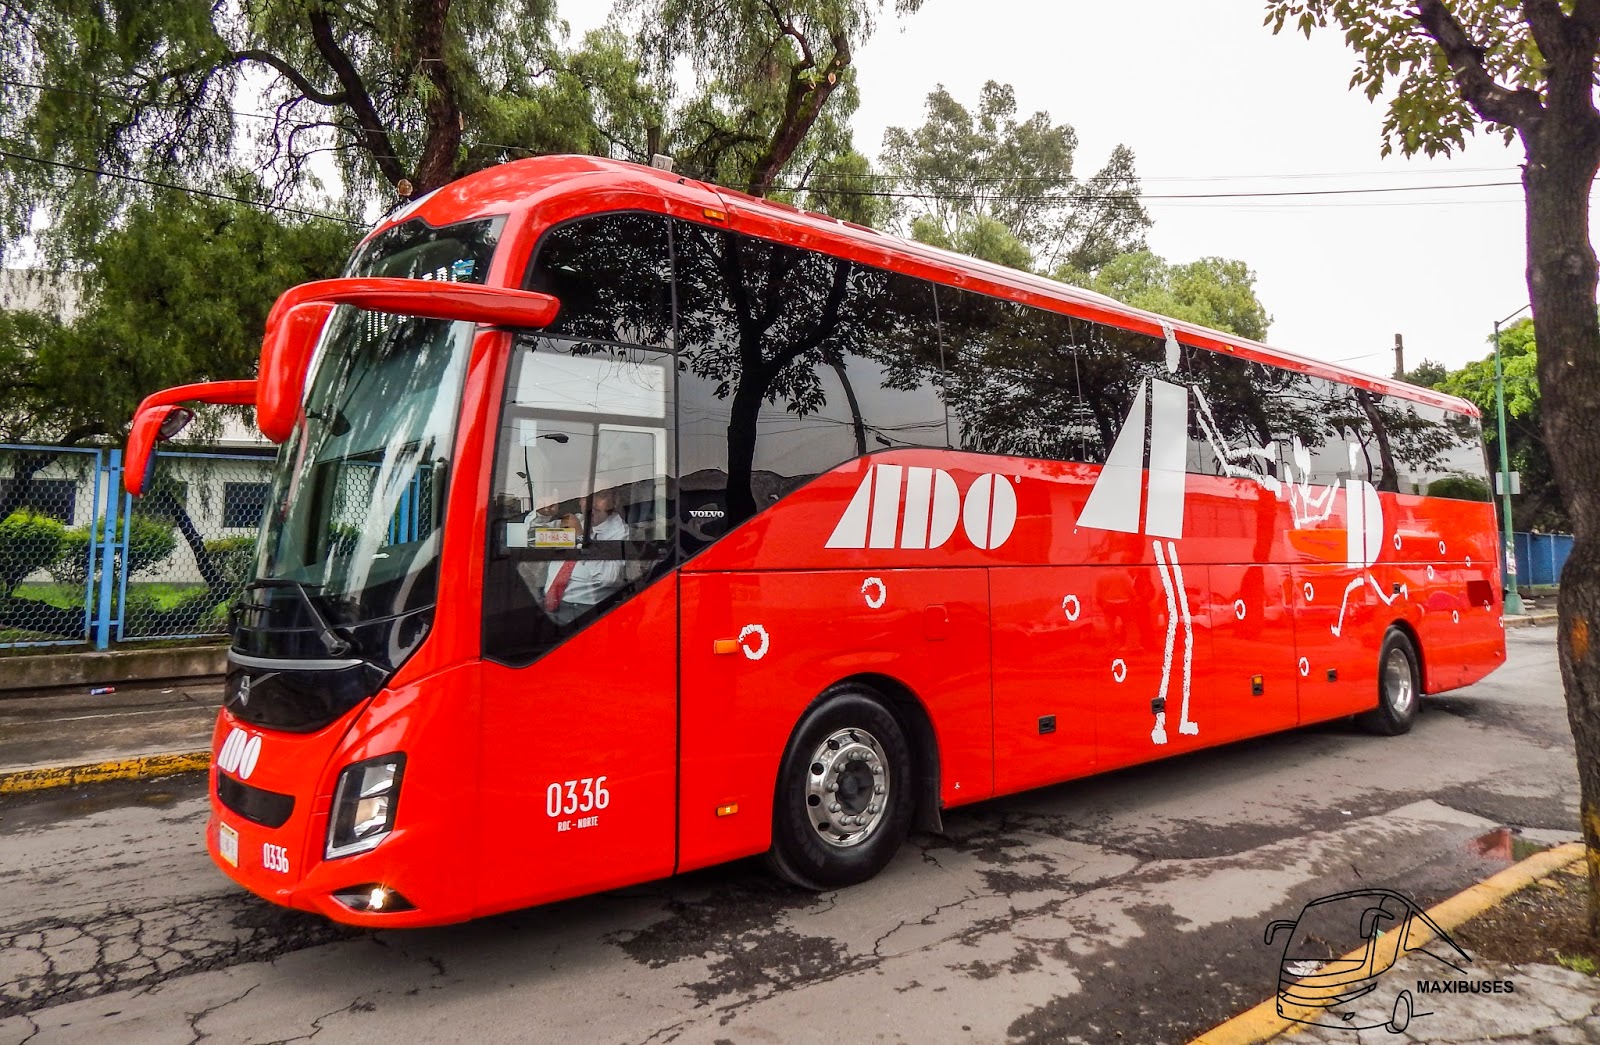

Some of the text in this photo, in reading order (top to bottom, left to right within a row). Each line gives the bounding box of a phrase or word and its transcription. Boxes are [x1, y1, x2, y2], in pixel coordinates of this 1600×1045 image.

[688, 510, 725, 518] VOLVO
[823, 463, 1018, 550] ADO
[546, 776, 610, 818] 0336
[577, 815, 599, 829] NORTE
[262, 842, 290, 874] 0336
